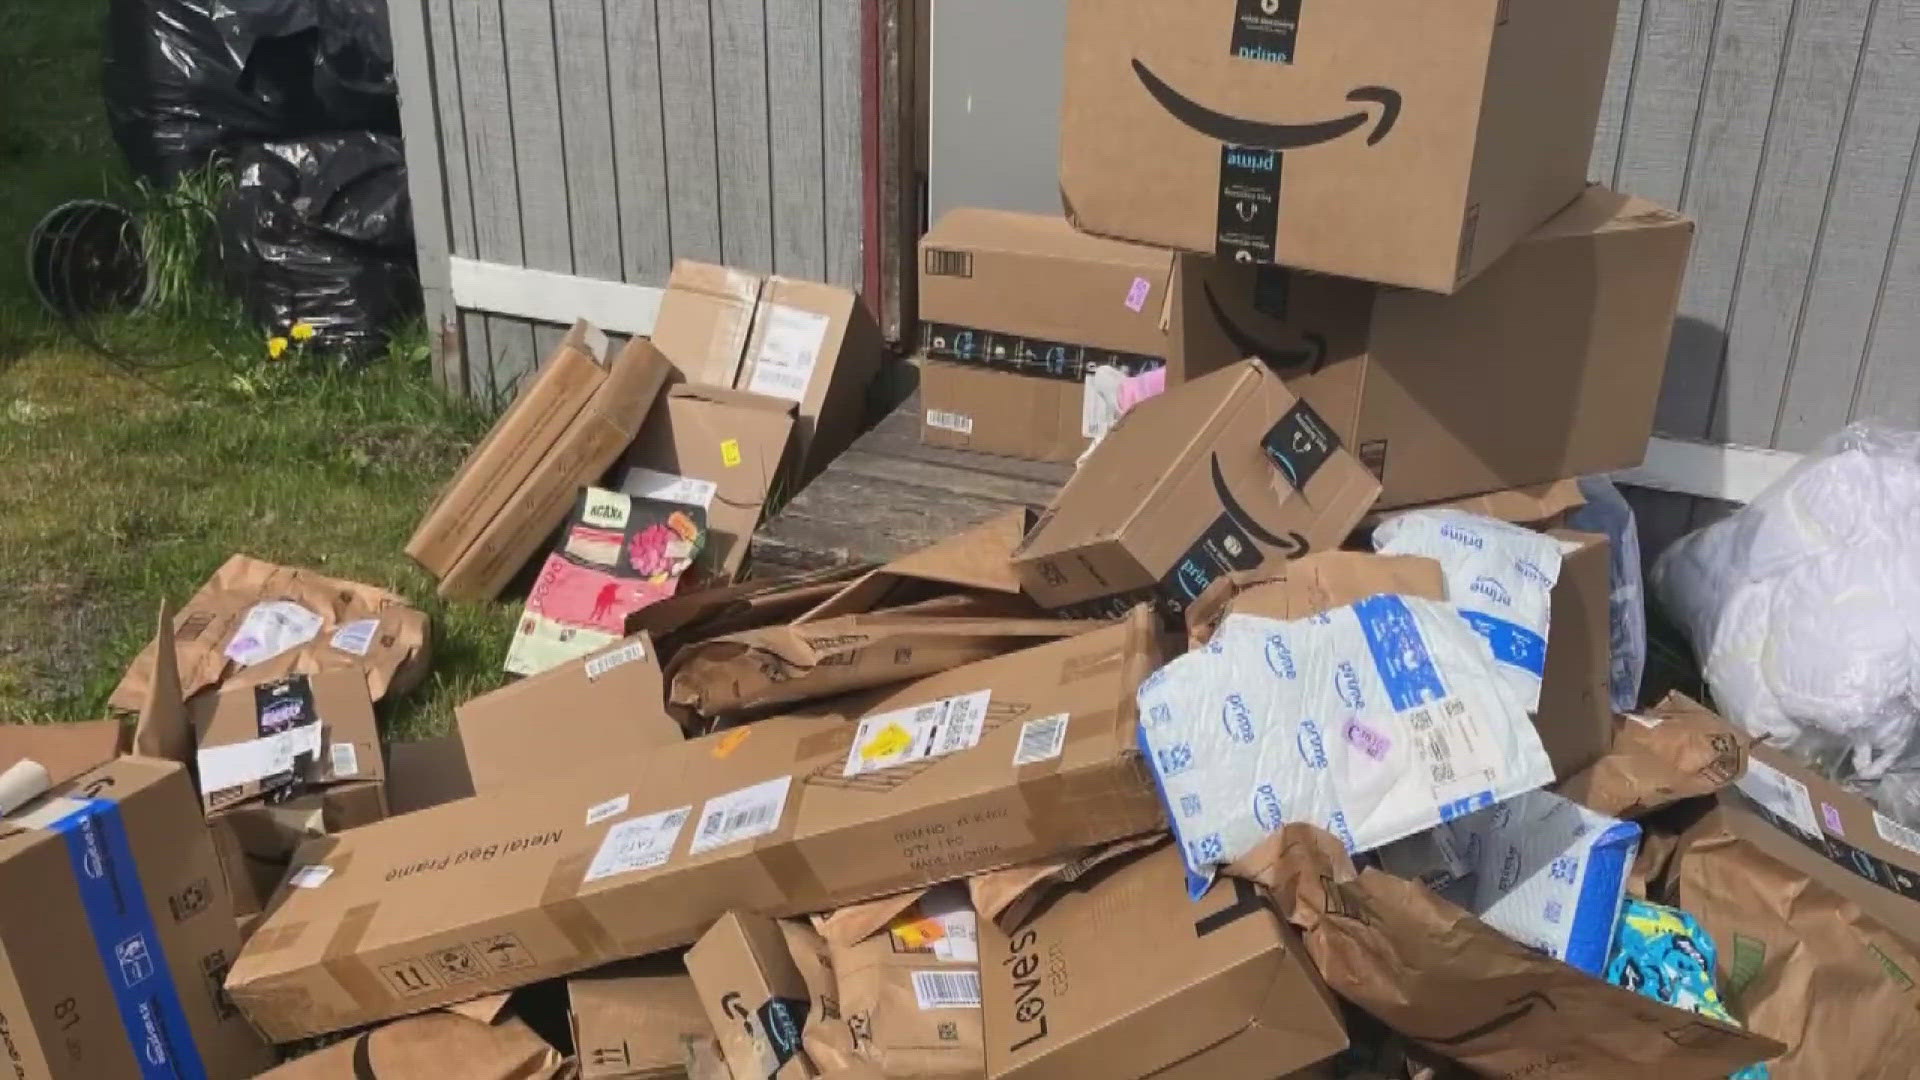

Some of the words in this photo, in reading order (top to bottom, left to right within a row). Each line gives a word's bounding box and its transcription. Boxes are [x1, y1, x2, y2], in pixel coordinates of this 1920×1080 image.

[1226, 151, 1274, 172] prime
[1270, 634, 1297, 681] prime
[1337, 661, 1365, 710] prime
[1227, 693, 1255, 744] prime
[1301, 718, 1329, 769] prime
[455, 844, 499, 866] Bed
[502, 829, 563, 857] Metal
[1002, 929, 1048, 1052] Love's
